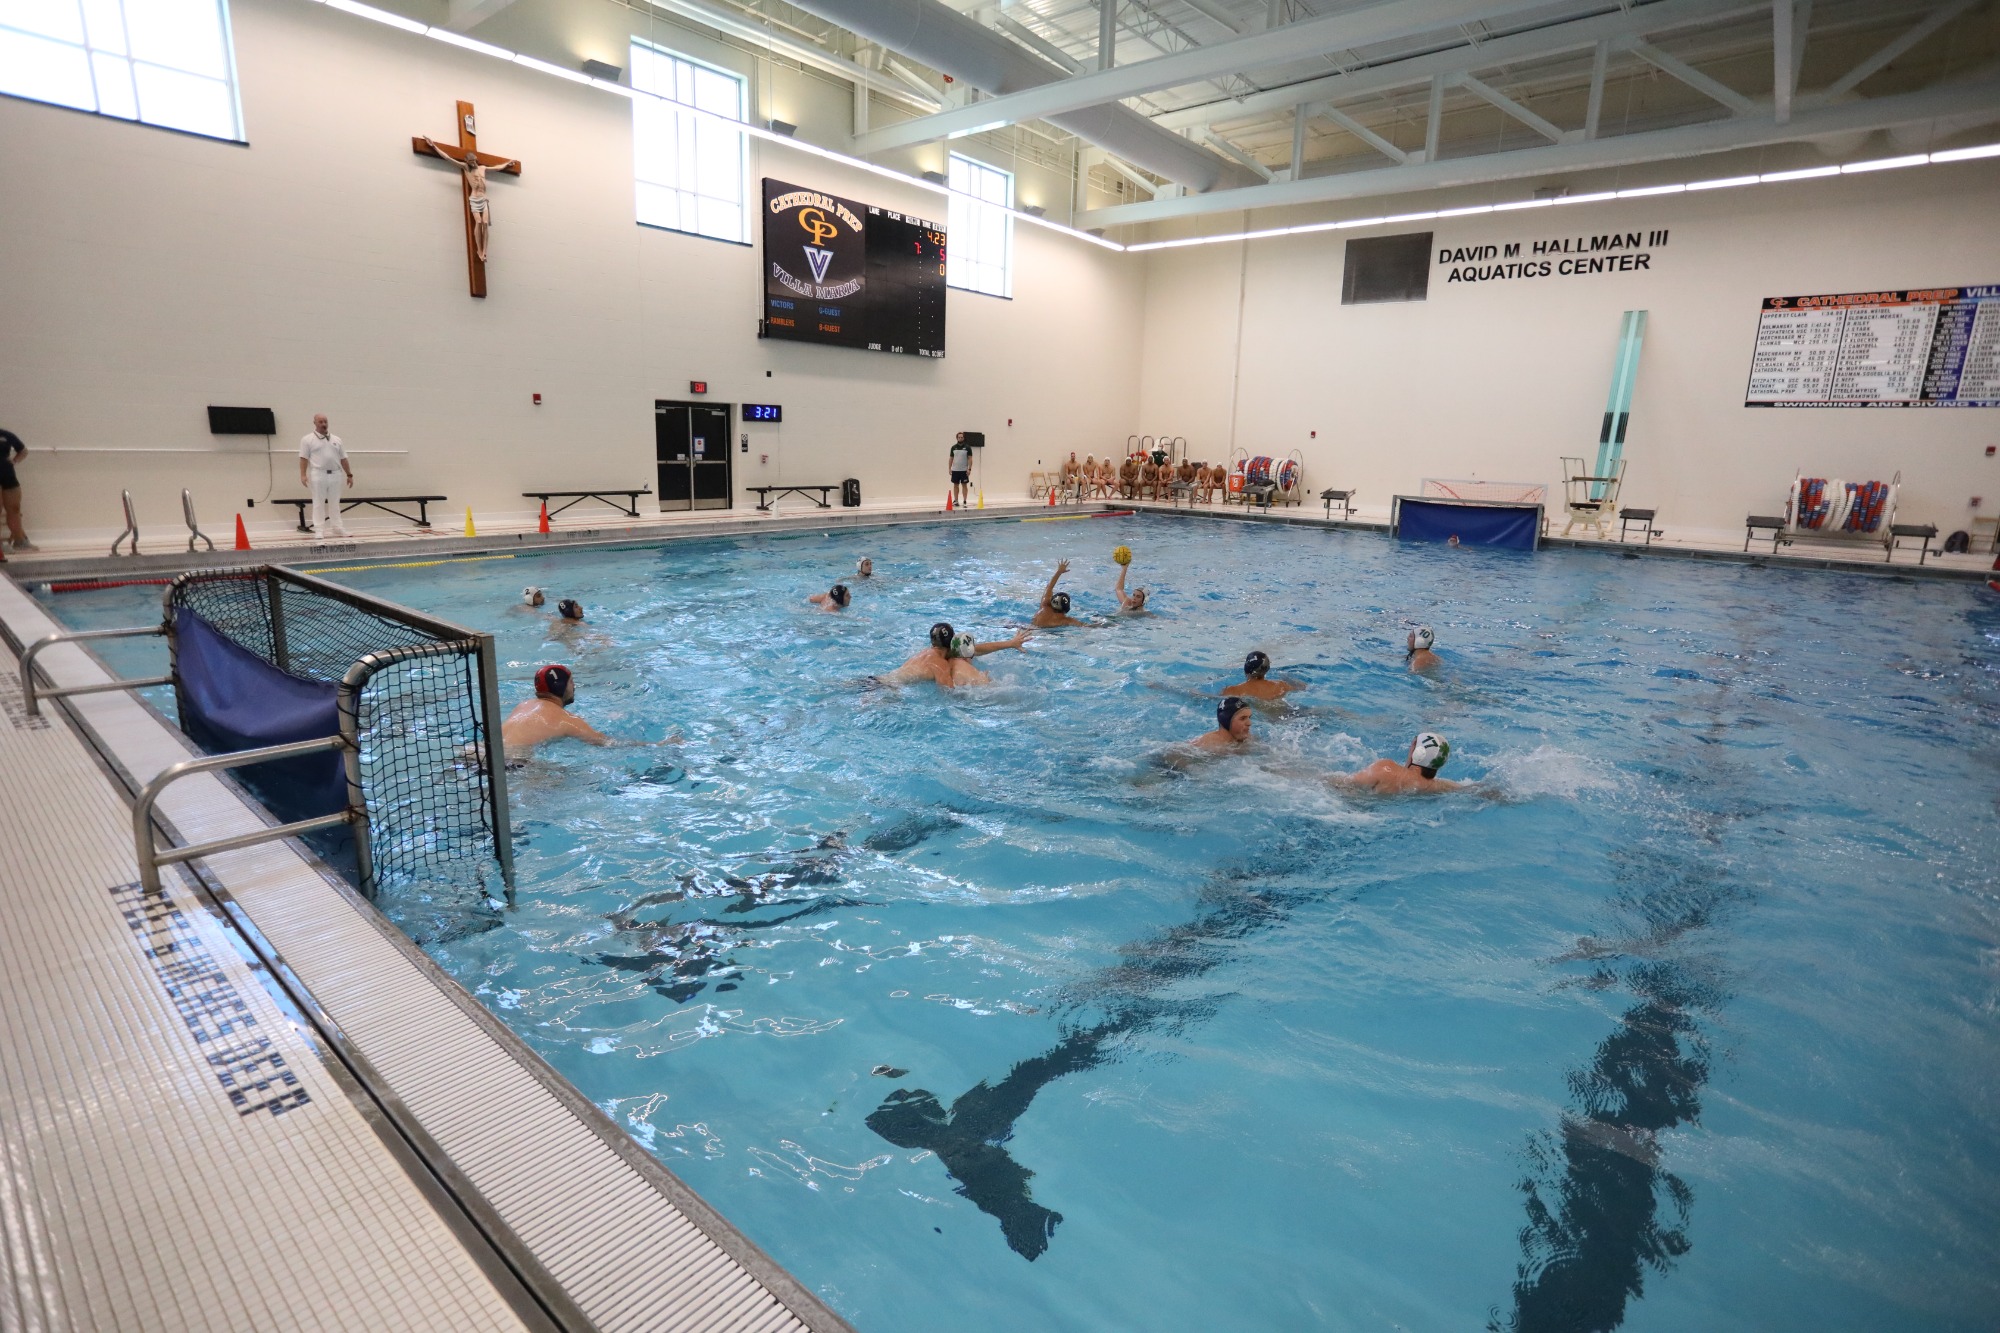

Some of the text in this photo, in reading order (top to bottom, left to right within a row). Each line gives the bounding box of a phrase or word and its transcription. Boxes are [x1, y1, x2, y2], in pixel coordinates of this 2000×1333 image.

[770, 192, 862, 232] CATHEDRAL PREP
[1439, 230, 1668, 264] DAVID M. HALLMAN III
[940, 248, 945, 260] 5
[939, 264, 945, 276] 0
[1448, 253, 1650, 282] AQUATICS CENTER
[773, 263, 860, 299] VILLA MARIA
[1797, 293, 1900, 306] CATHEDRAL
[1907, 289, 1958, 300] PREP
[771, 300, 794, 309] VICTORS
[756, 406, 776, 418] 3:21
[942, 627, 949, 637] 5
[1419, 629, 1430, 639] 10
[549, 669, 558, 680] 1
[1219, 700, 1225, 710] 4
[1422, 735, 1439, 749] 17
[152, 952, 260, 1043] INCHES
[205, 1036, 312, 1122] DEEP
